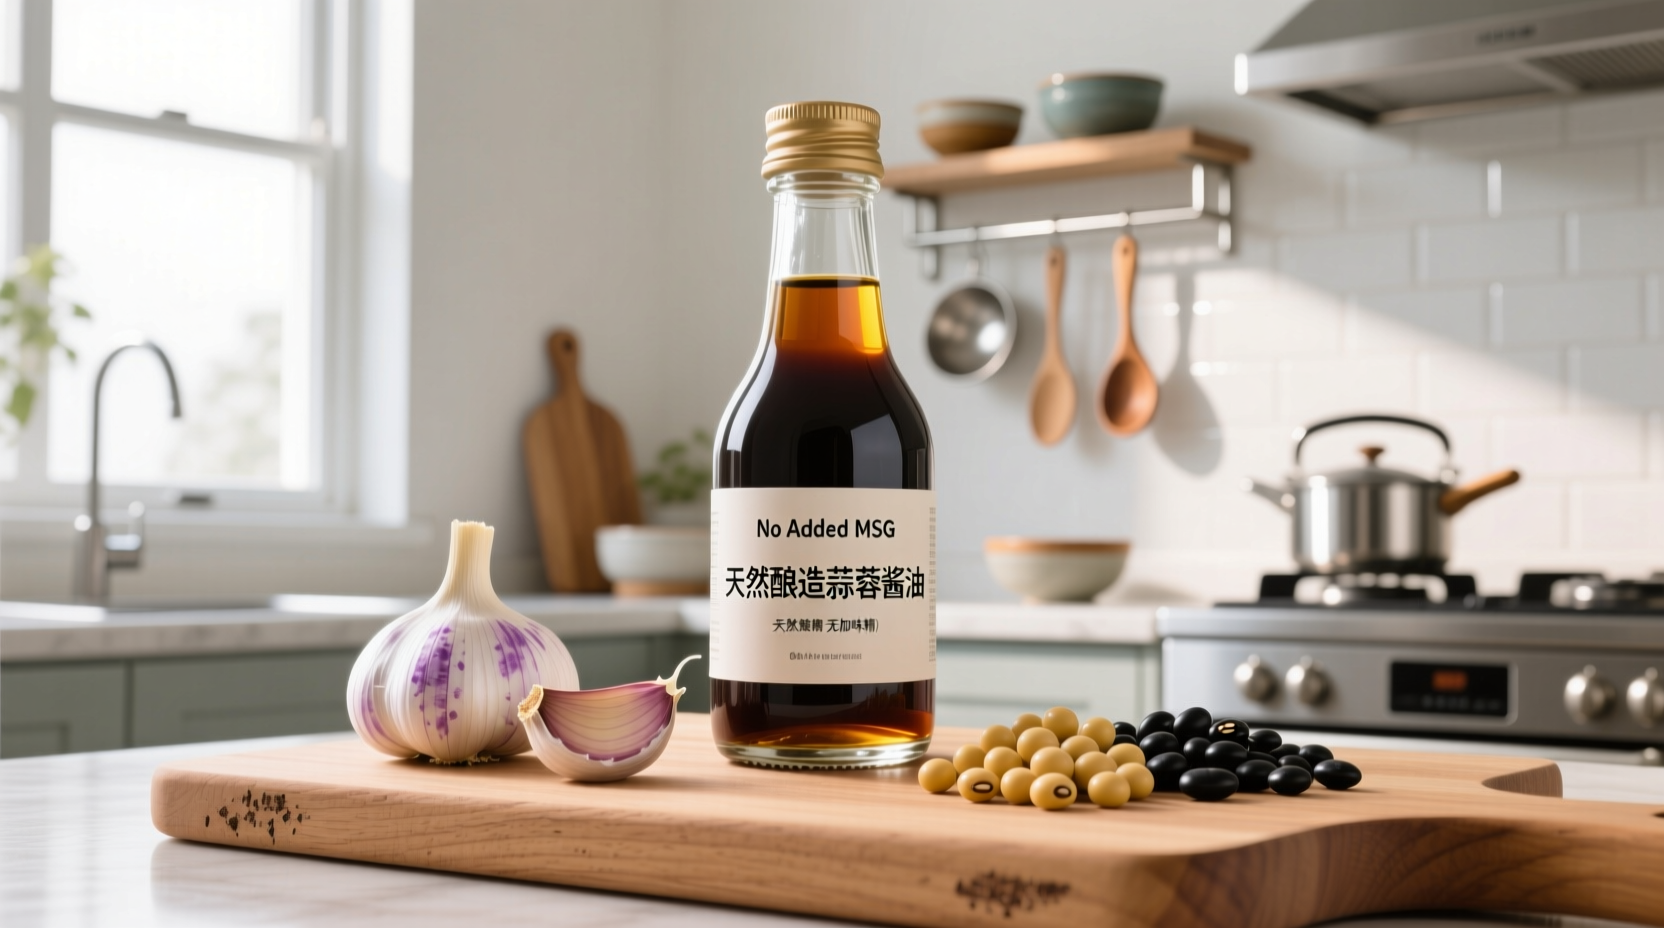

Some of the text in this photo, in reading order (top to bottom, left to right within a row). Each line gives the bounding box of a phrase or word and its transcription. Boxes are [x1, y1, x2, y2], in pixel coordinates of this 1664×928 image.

[757, 518, 896, 538] No Added MSG
[725, 565, 925, 600] 天然酿造蒜蓉酱油
